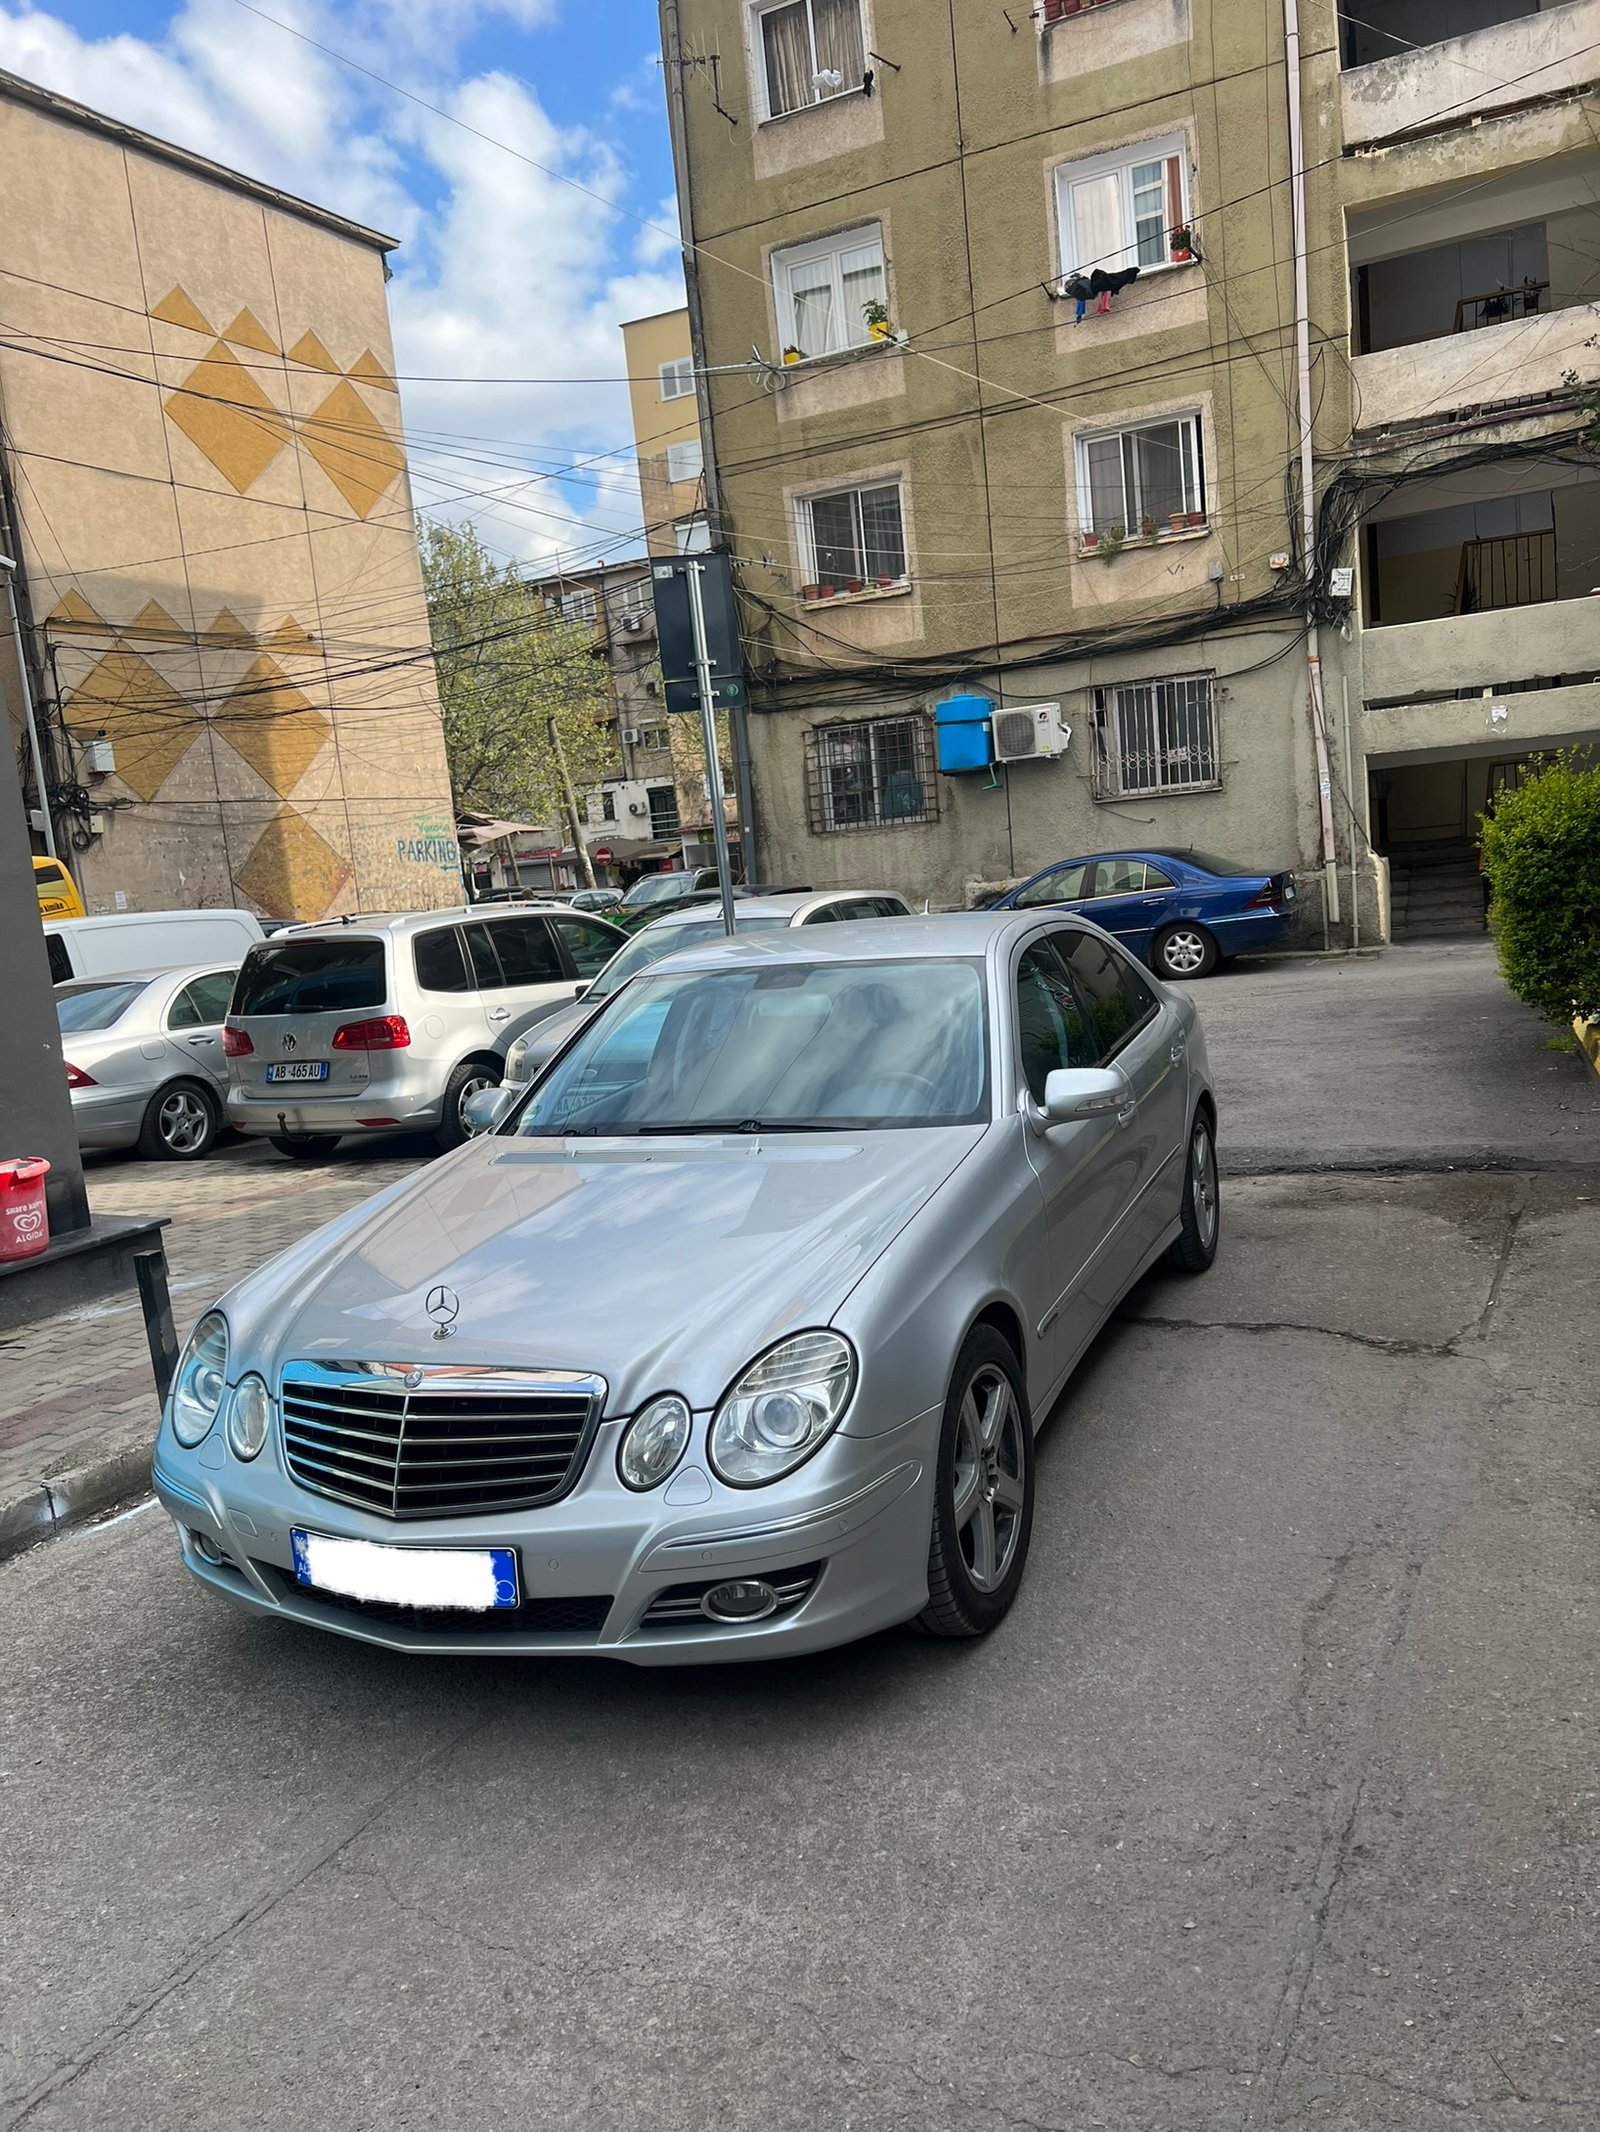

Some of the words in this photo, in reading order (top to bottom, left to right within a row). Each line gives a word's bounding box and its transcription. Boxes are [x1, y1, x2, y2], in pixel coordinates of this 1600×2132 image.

[398, 840, 457, 862] PARKING
[275, 1066, 286, 1078] AB
[290, 1065, 307, 1077] 465
[308, 1064, 320, 1077] AU
[15, 1230, 43, 1243] ALGIDA
